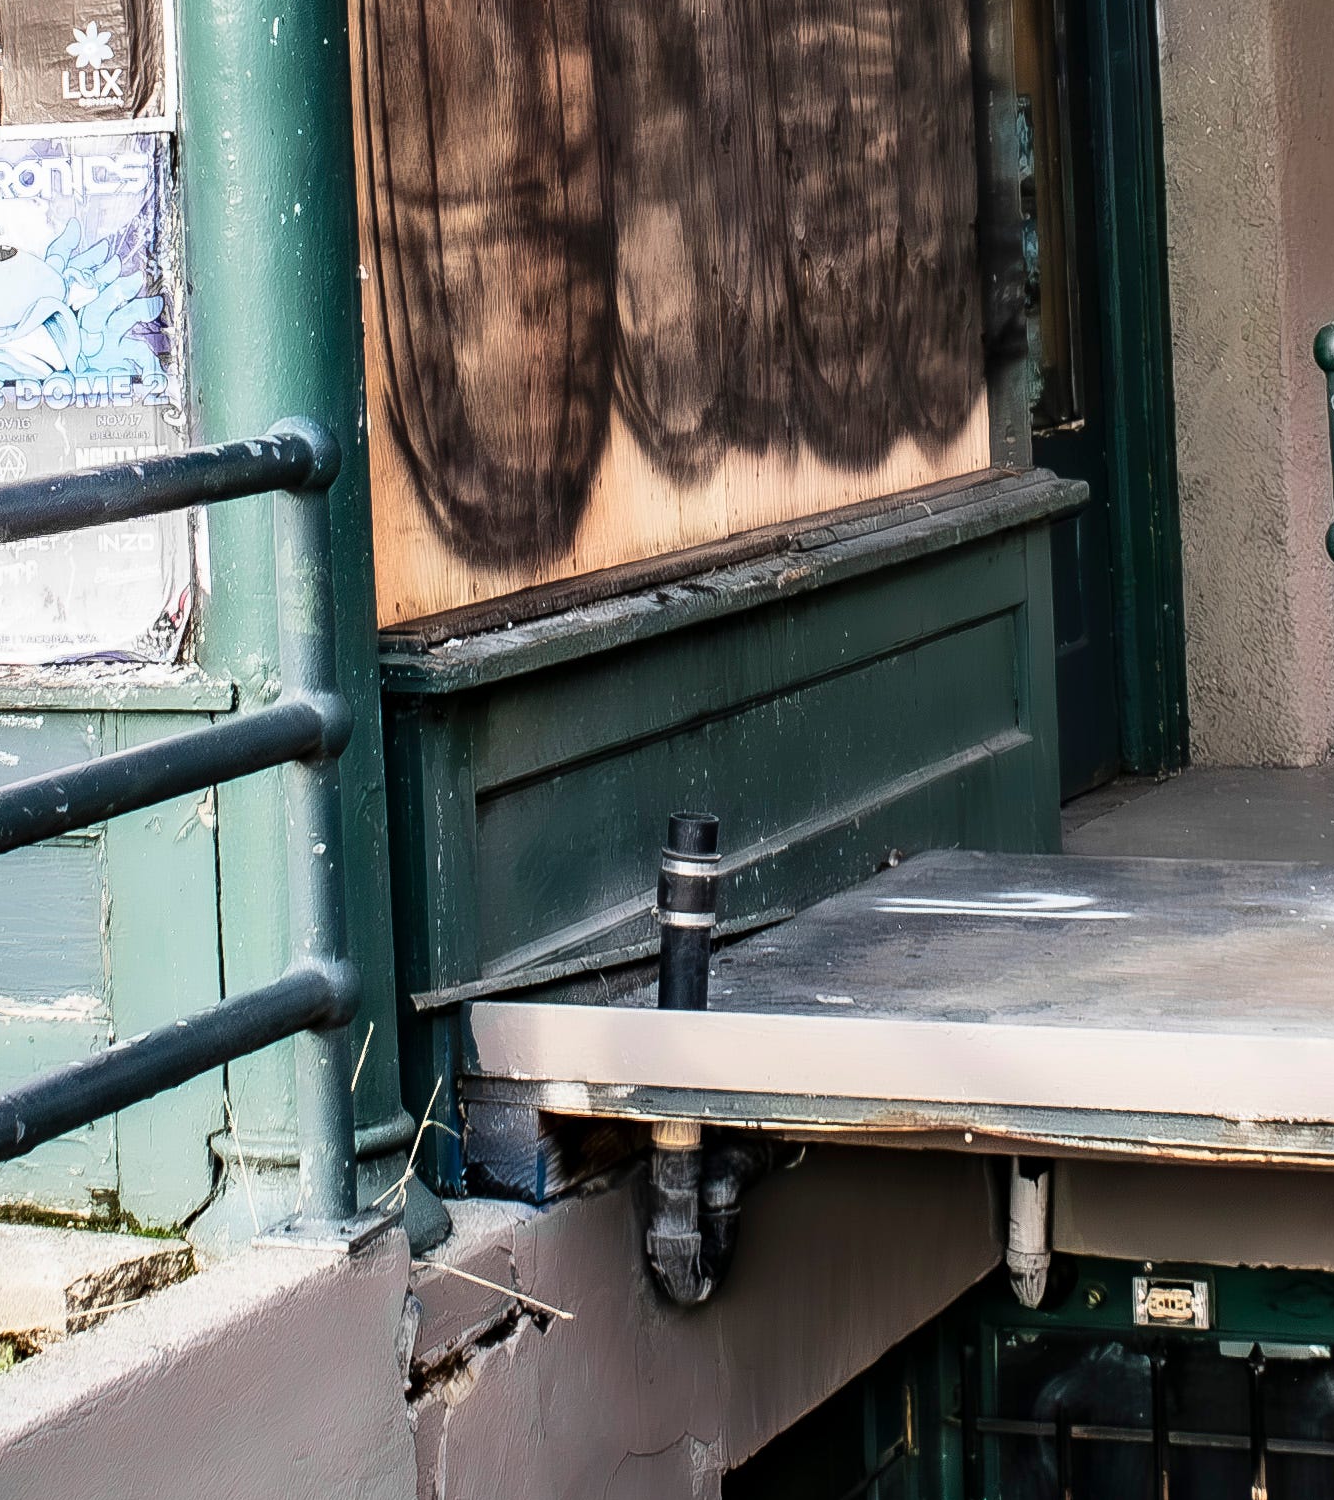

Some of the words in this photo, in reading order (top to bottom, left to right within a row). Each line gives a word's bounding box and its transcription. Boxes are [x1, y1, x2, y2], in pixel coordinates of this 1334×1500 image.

[62, 68, 124, 100] LUX
[15, 371, 135, 411] DOME
[142, 373, 170, 407] 2
[98, 533, 150, 552] INZO
